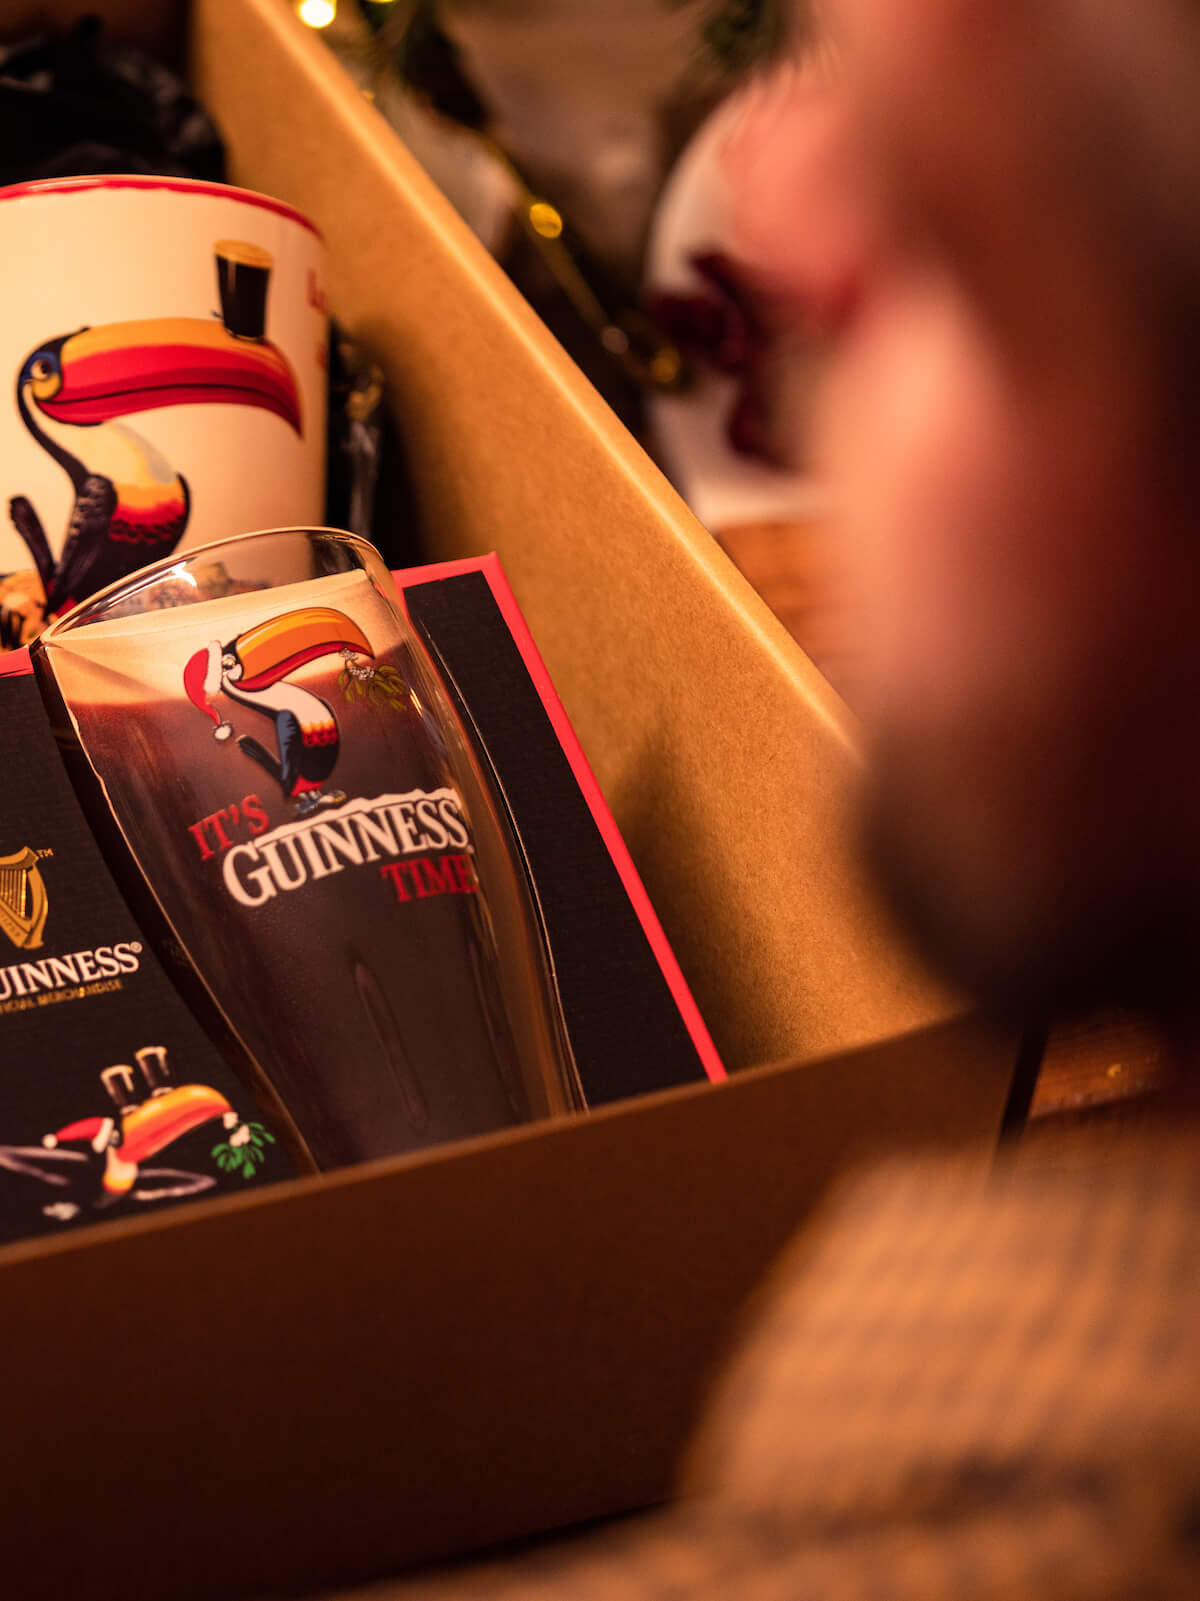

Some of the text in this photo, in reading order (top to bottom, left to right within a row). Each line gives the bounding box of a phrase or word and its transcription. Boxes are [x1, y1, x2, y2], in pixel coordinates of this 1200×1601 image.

[188, 794, 270, 861] IT'S
[222, 798, 474, 908] GUINNESS
[380, 854, 478, 903] TIME
